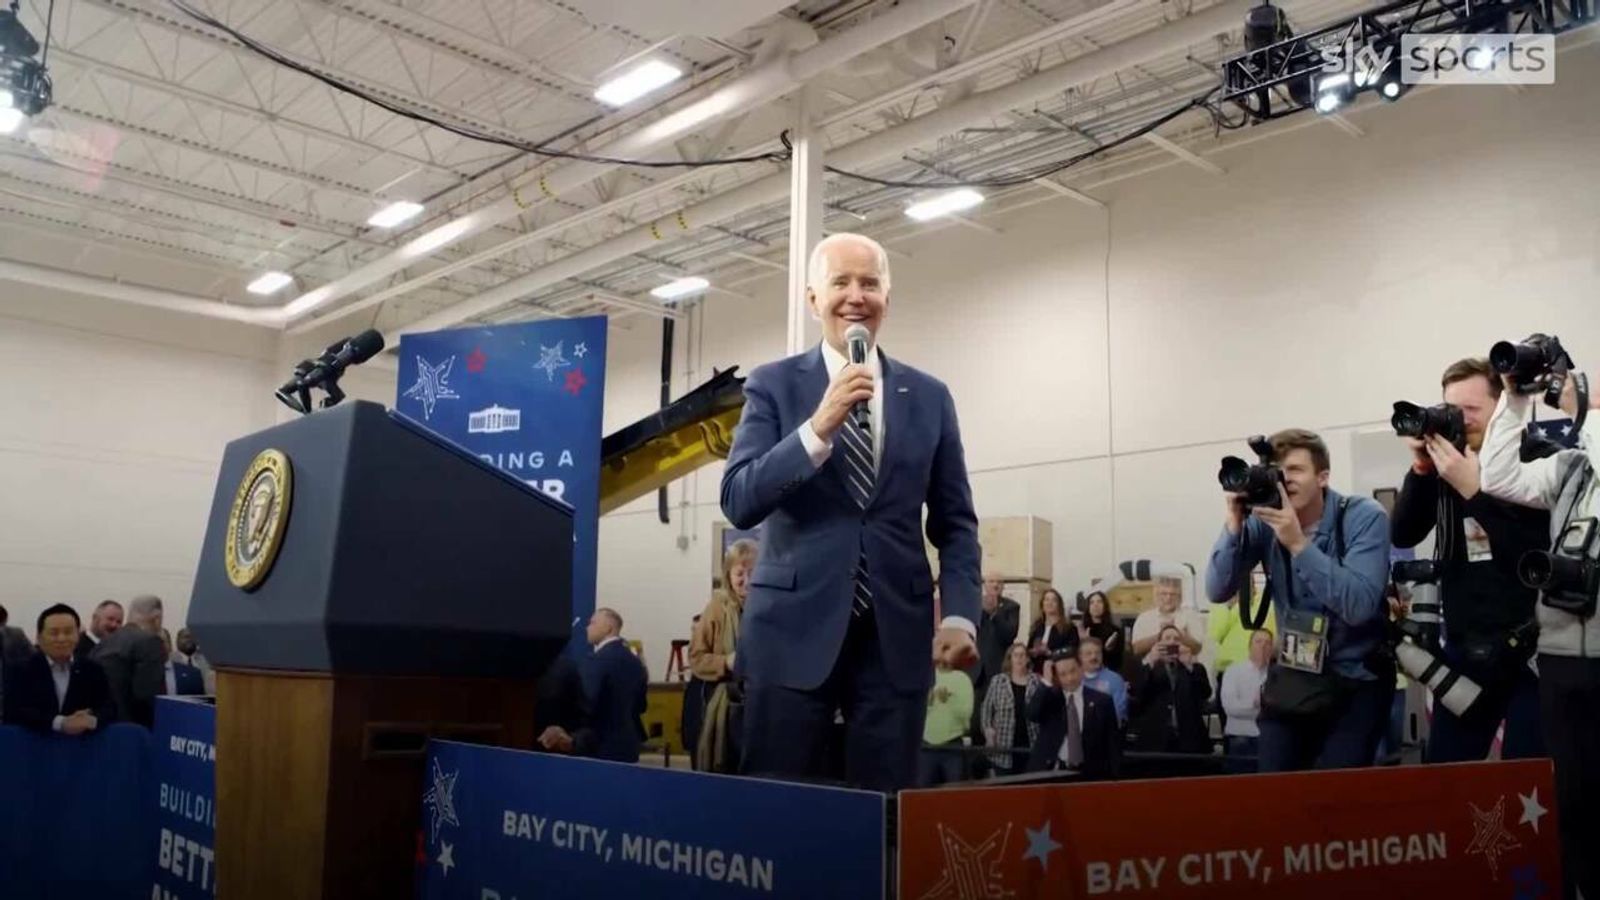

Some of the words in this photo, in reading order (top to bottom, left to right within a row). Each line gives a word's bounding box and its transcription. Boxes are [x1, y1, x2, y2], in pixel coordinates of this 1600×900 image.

[558, 449, 573, 467] A
[170, 735, 188, 753] BAY
[186, 740, 208, 761] CITY,
[160, 783, 216, 829] BUILDI
[159, 827, 216, 895] BETT
[503, 810, 547, 842] BAY
[552, 820, 613, 863] CITY,
[621, 833, 773, 891] MICHIGAN
[1086, 857, 1166, 895] BAY
[1178, 847, 1272, 884] CITY,
[1284, 832, 1448, 875] MICHIGAN
